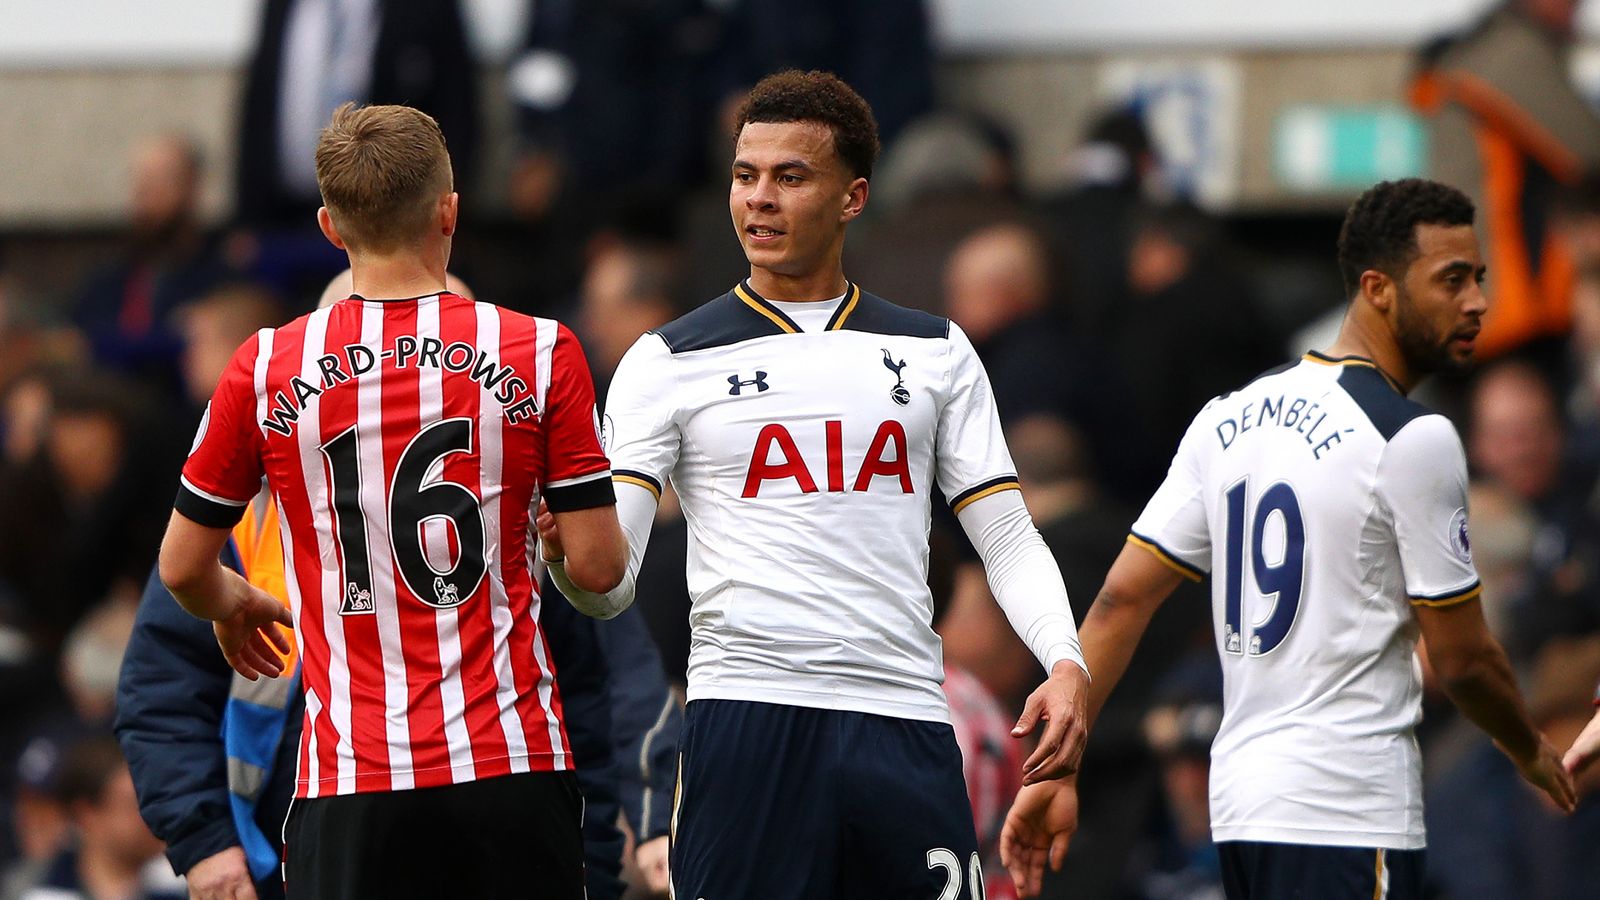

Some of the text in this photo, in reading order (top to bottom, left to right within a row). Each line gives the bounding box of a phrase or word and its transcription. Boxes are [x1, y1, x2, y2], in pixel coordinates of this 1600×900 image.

[263, 336, 538, 437] WARD-PROWSE
[320, 417, 488, 616] 16
[741, 420, 914, 498] AIA
[1223, 475, 1306, 657] 19
